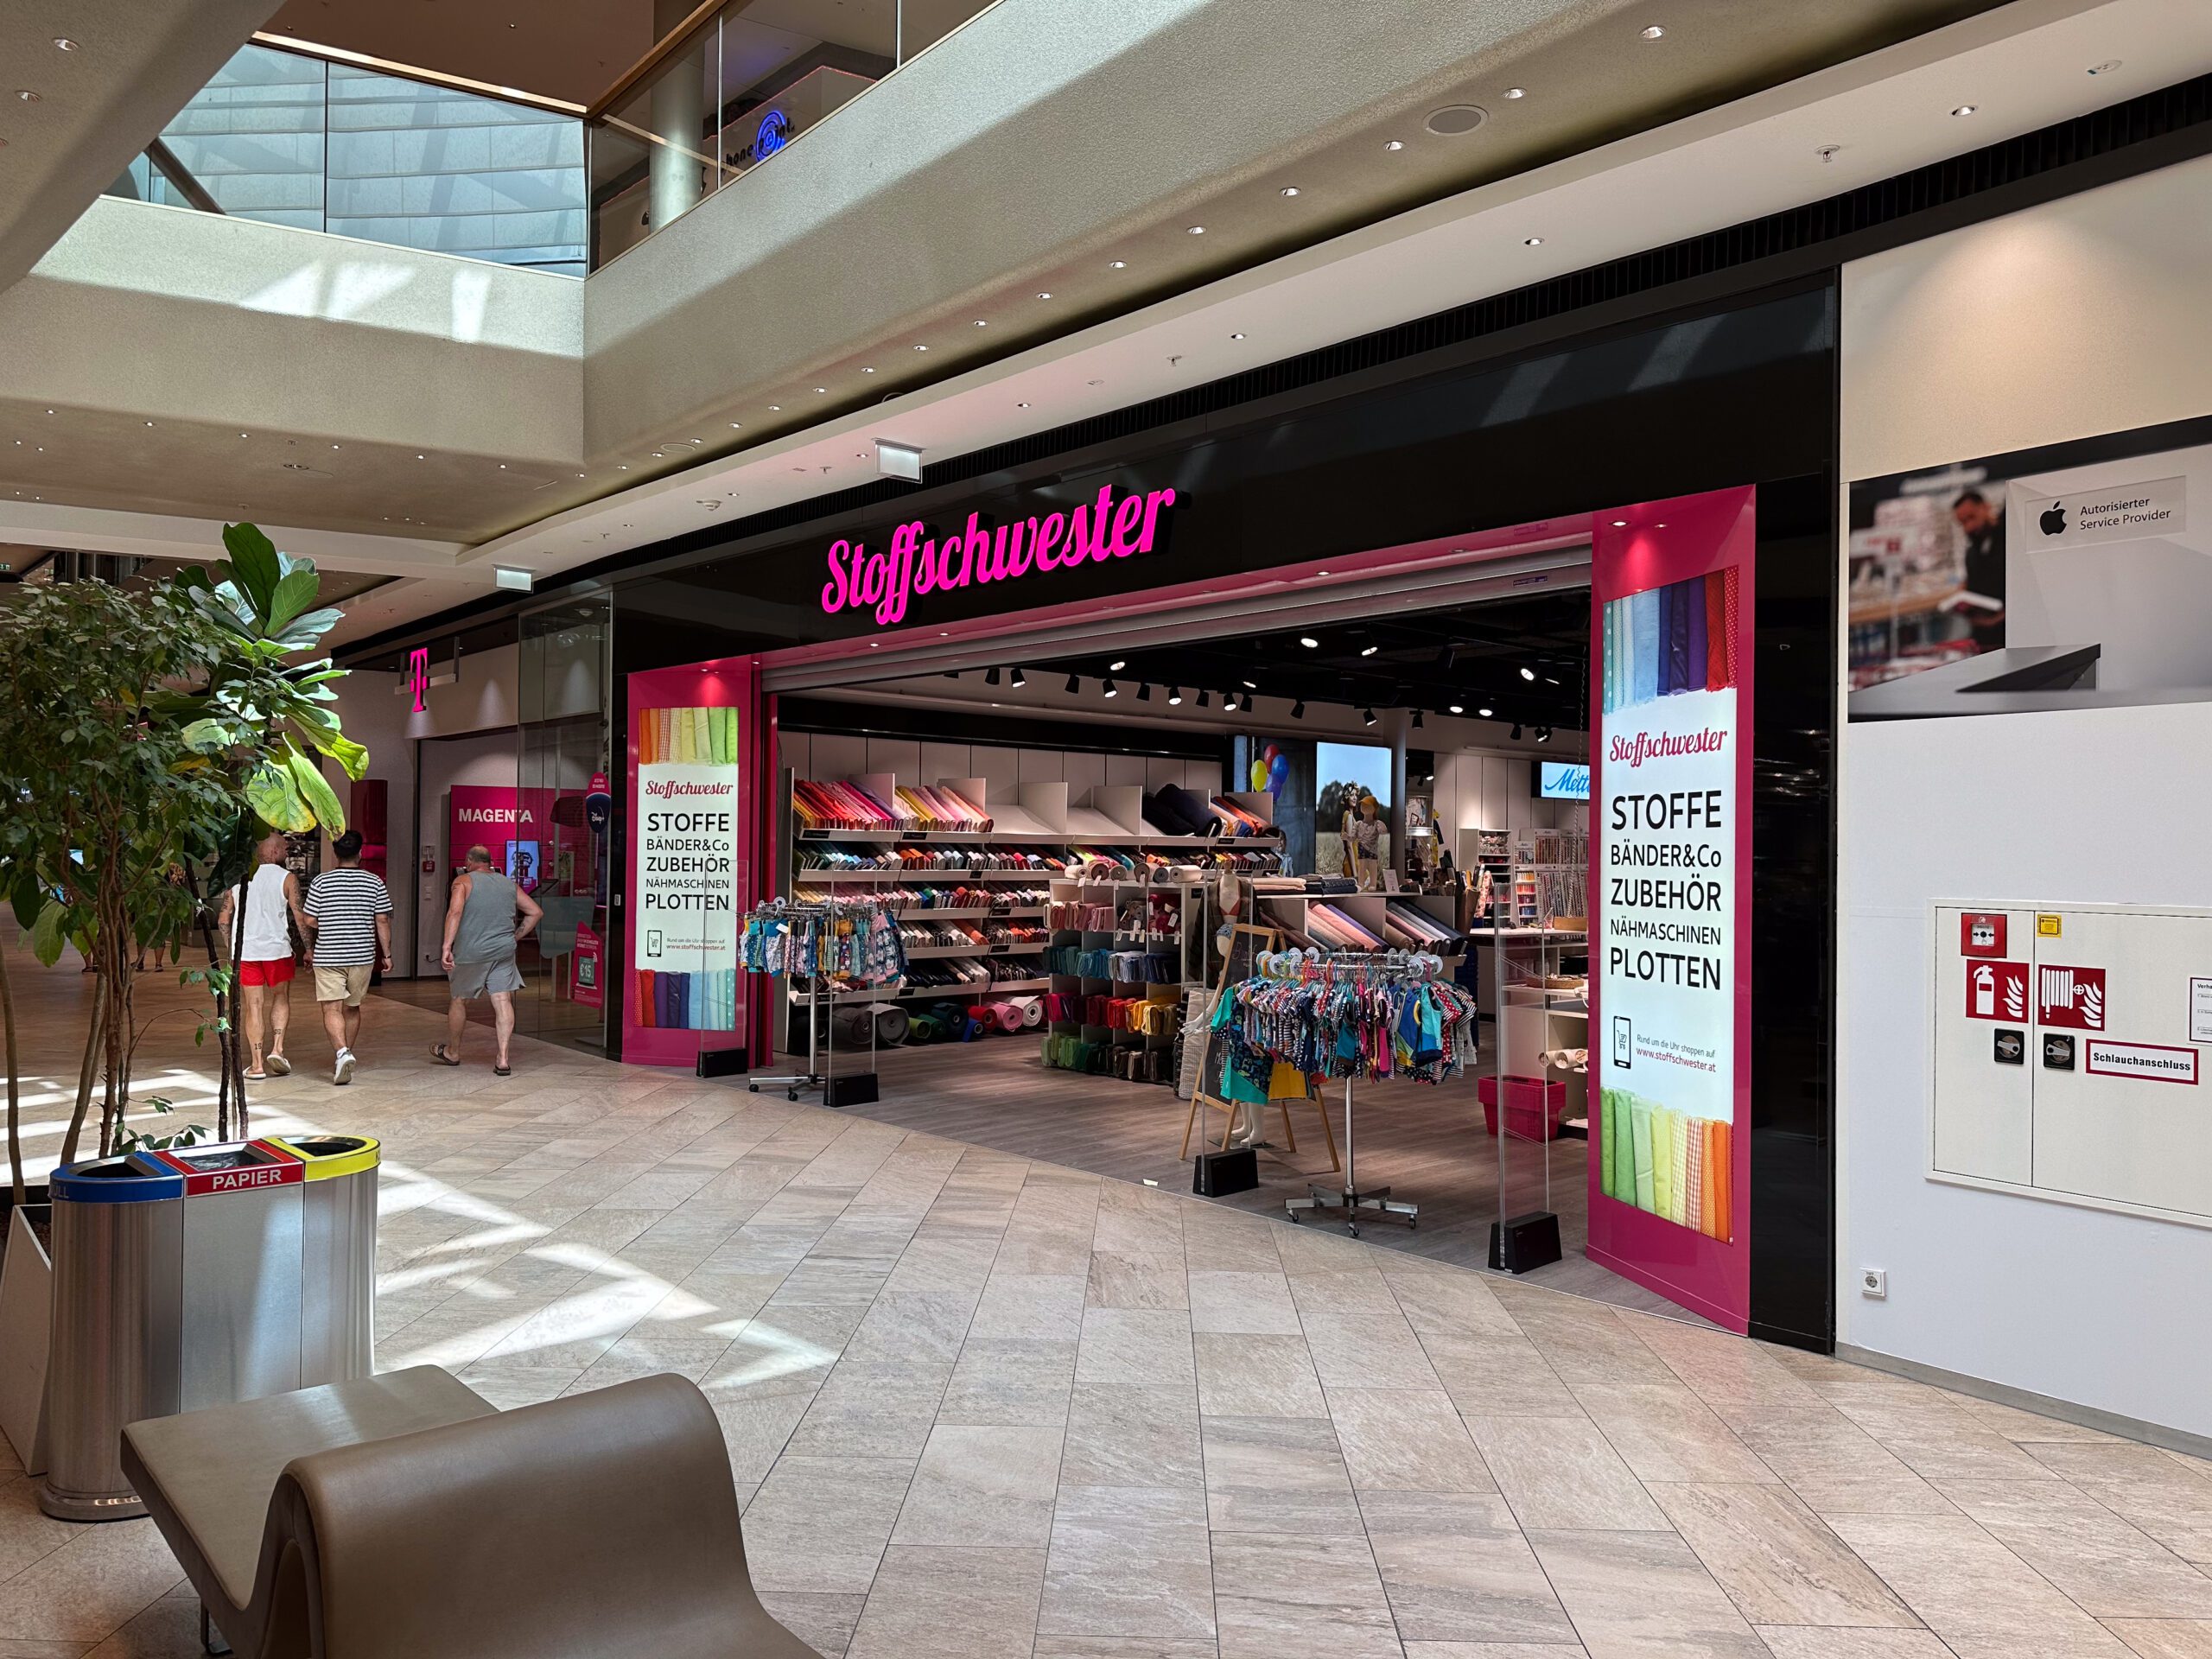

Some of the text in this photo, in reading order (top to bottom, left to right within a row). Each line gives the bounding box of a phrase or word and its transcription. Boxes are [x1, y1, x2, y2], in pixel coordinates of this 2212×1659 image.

[2080, 499, 2151, 516] Autorisierter
[2080, 510, 2171, 531] Service Provider
[822, 483, 1175, 626] Stoffschwester
[1610, 727, 1728, 768] Stoffschwester
[645, 780, 734, 799] Stoffschwester
[1611, 790, 1722, 830] STOFFE
[647, 812, 730, 832] STOFFE
[646, 836, 729, 852] BÄNDER&Co
[1611, 838, 1722, 868] BÄNDER&Co
[646, 854, 730, 873] ZUBEHÖR
[645, 876, 729, 889] NÄHMASCHINEN
[1611, 873, 1722, 912] ZUBEHÖR
[645, 893, 729, 911] PLOTTEN
[1611, 915, 1721, 945] NÄHMASCHINEN
[1610, 947, 1721, 990] PLOTTEN
[1637, 1033, 1650, 1045] Rund
[1660, 1039, 1669, 1049] die
[1669, 1040, 1680, 1051] Uhr
[1681, 1045, 1705, 1056] shoppen
[1705, 1049, 1715, 1058] auf
[1636, 1046, 1717, 1073] www.stoffschwester.at
[2093, 1052, 2191, 1071] Schlauchanschluss
[213, 1169, 283, 1190] PAPIER
